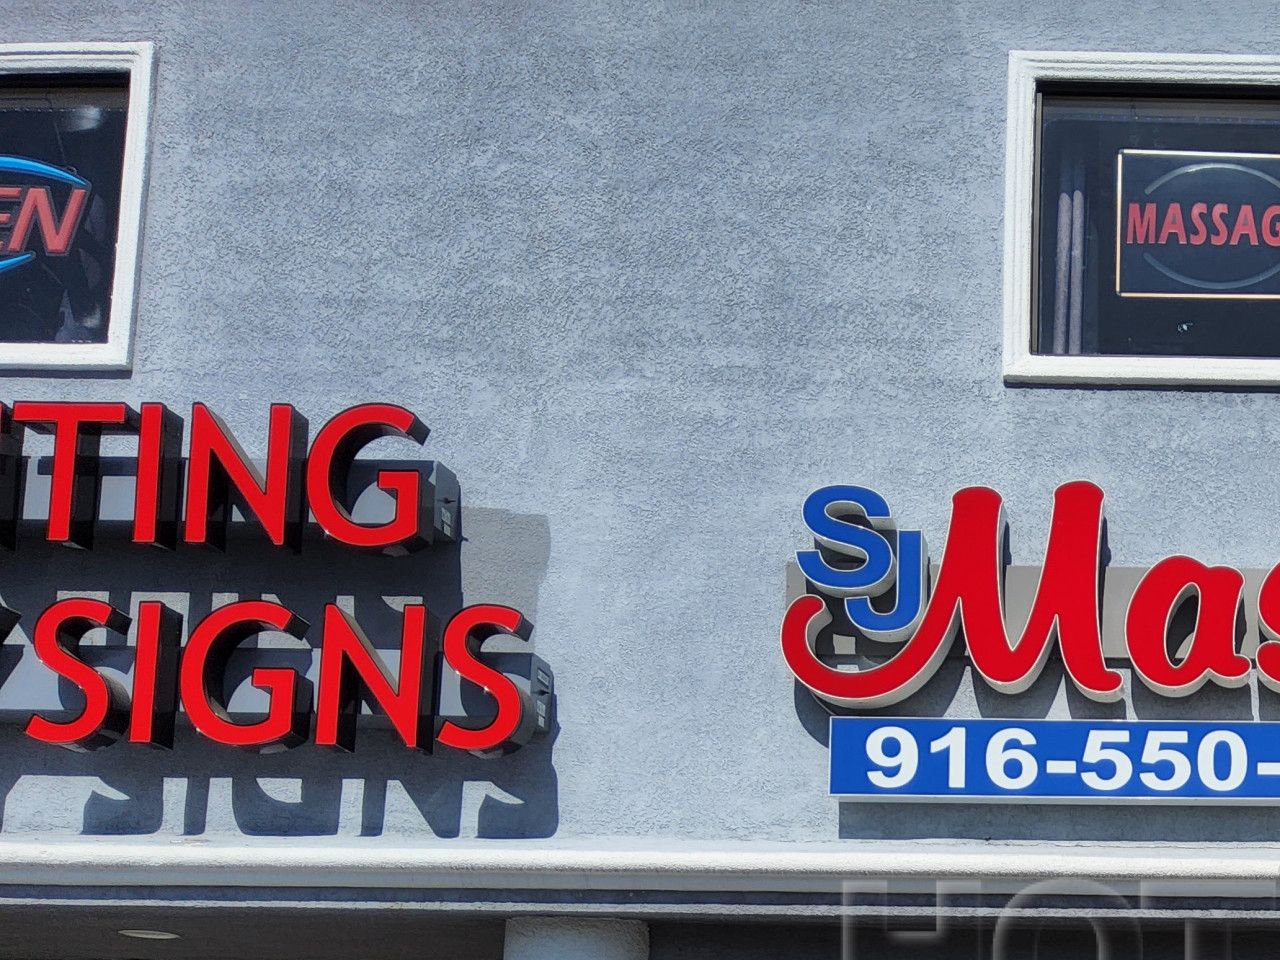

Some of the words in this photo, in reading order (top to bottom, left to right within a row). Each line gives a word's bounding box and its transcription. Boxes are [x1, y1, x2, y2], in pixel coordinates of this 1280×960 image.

[0, 402, 428, 547] TING
[795, 484, 923, 632] SJ
[25, 597, 524, 750] SIGNS
